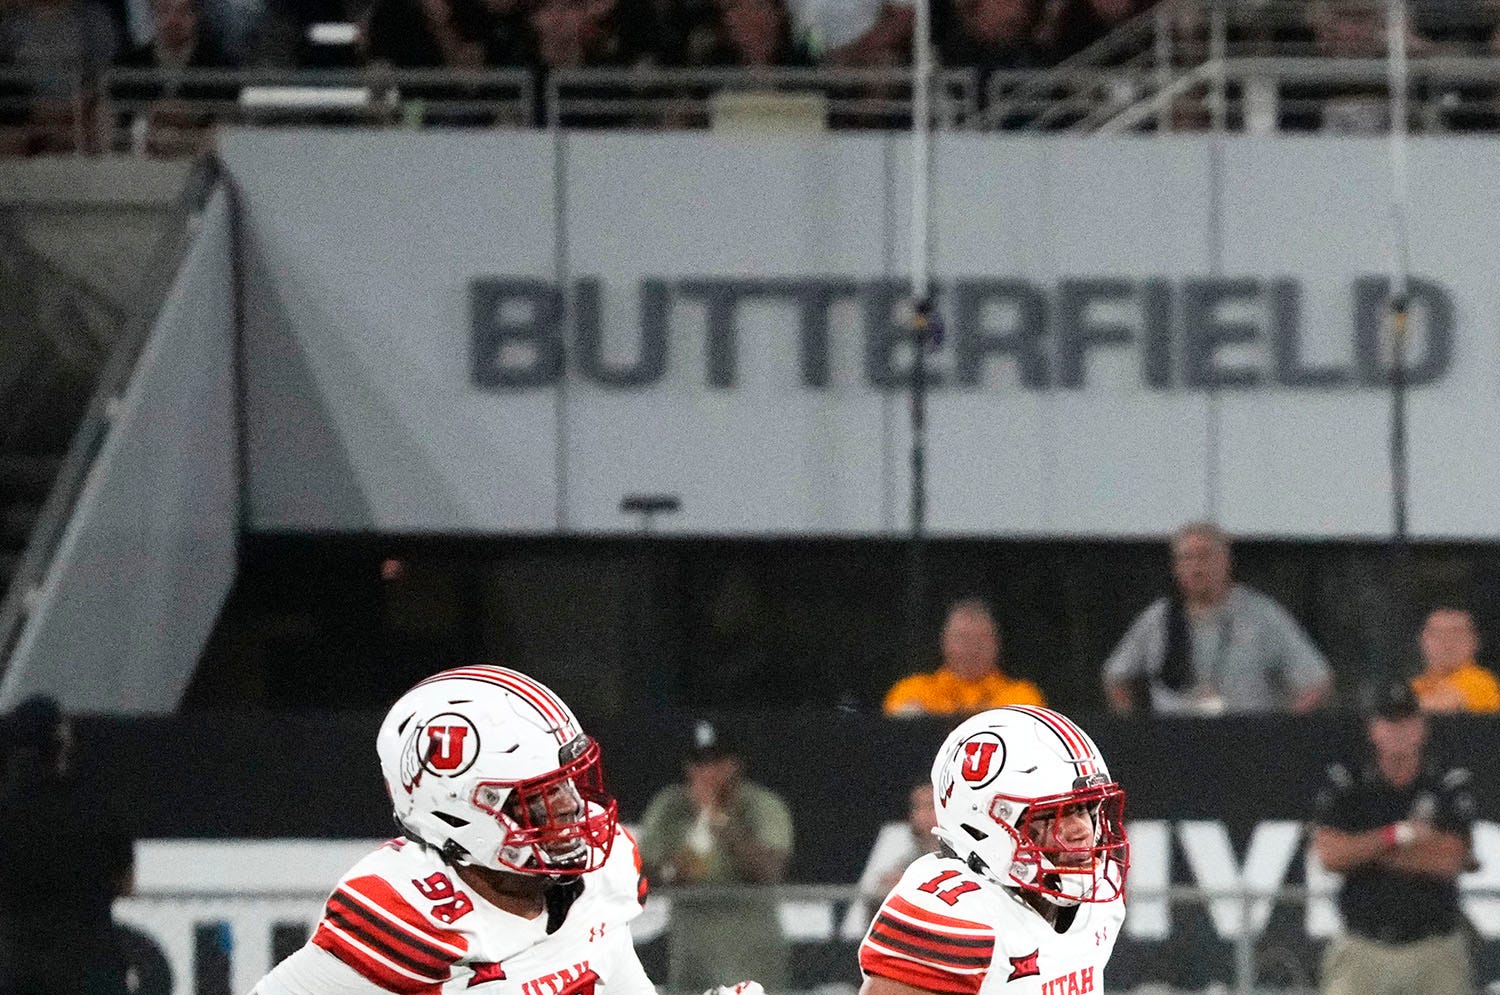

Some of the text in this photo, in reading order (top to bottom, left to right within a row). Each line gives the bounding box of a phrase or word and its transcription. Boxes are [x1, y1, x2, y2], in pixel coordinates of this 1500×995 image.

[468, 275, 1456, 391] BUTTERFIELD
[427, 726, 468, 770] U
[961, 742, 999, 782] U
[411, 871, 474, 924] 98
[917, 870, 982, 907] 11
